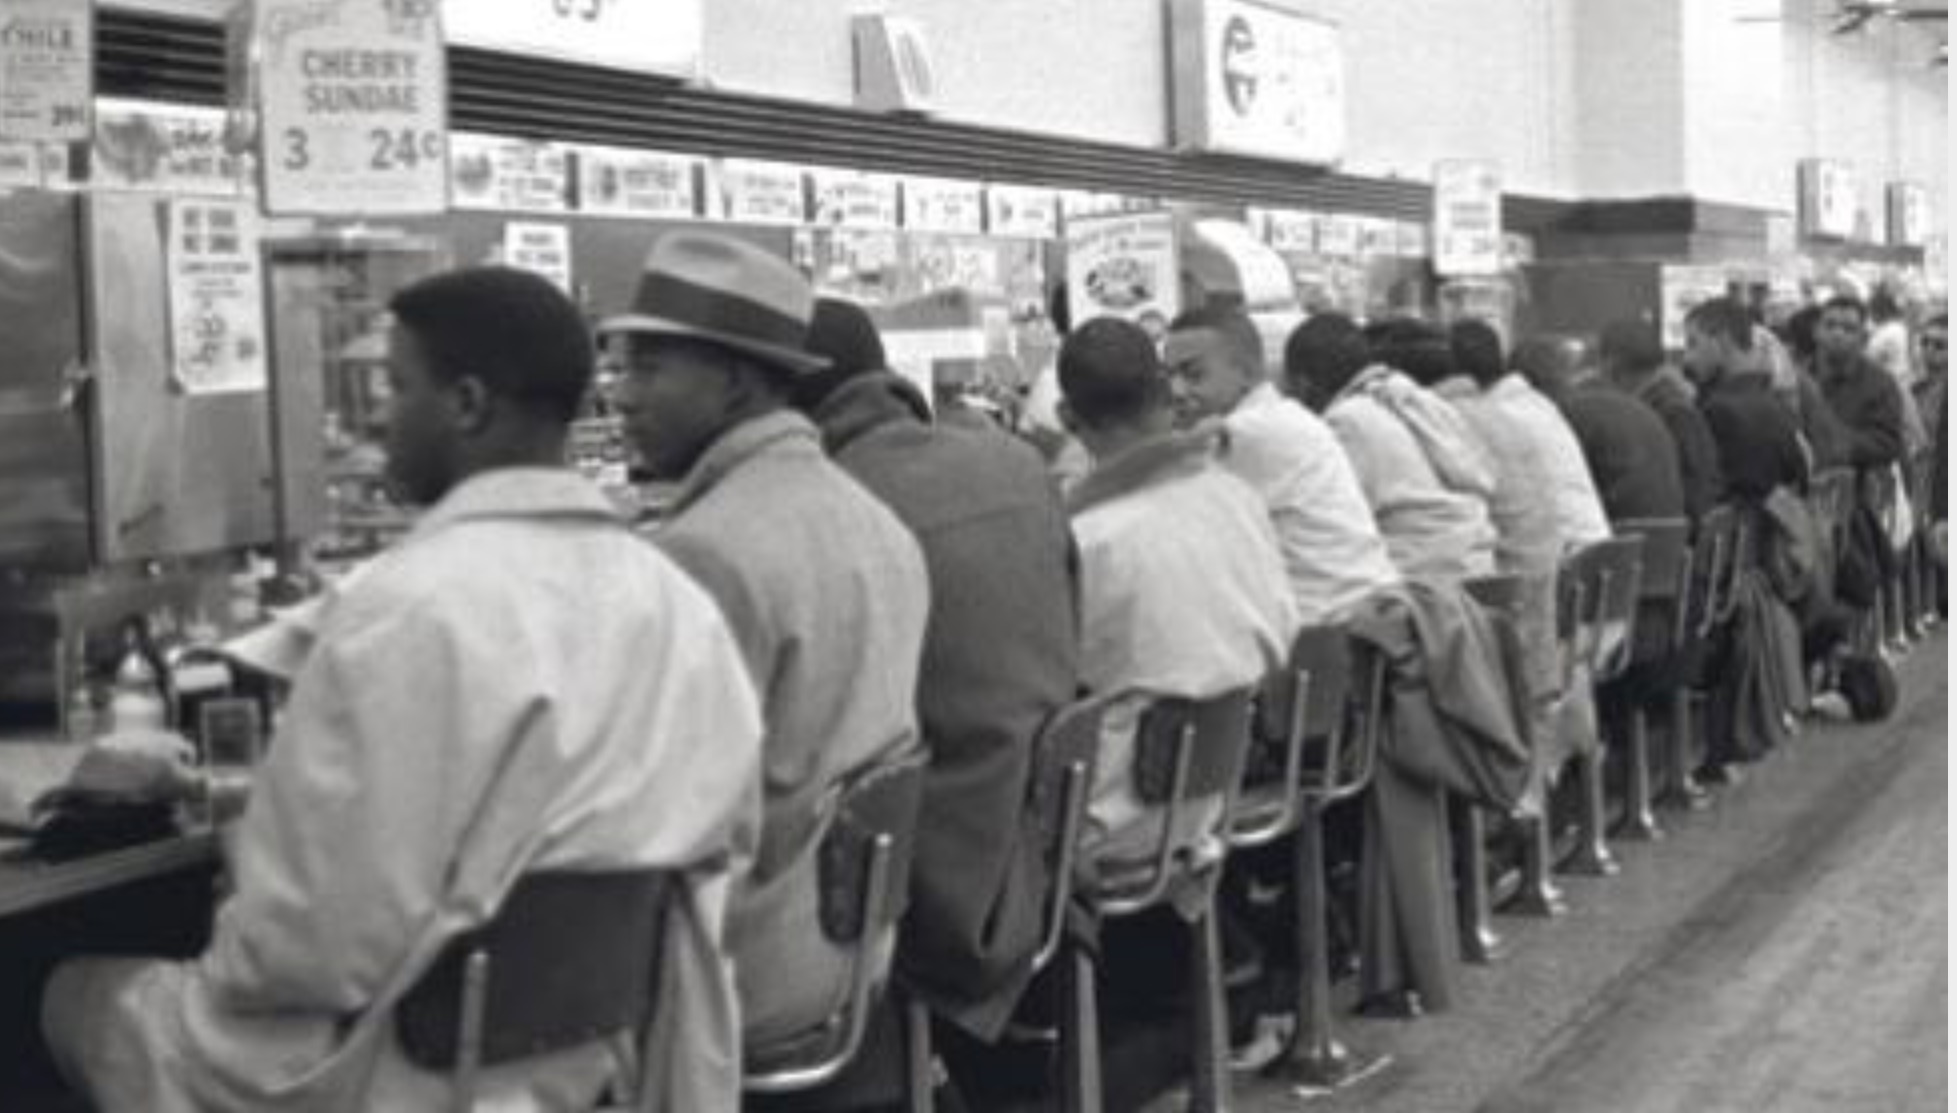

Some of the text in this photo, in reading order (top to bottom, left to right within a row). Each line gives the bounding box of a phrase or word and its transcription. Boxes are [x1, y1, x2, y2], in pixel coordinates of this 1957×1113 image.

[303, 50, 418, 78] CHERRY
[305, 84, 419, 114] SUNDAE
[283, 128, 309, 170] 3
